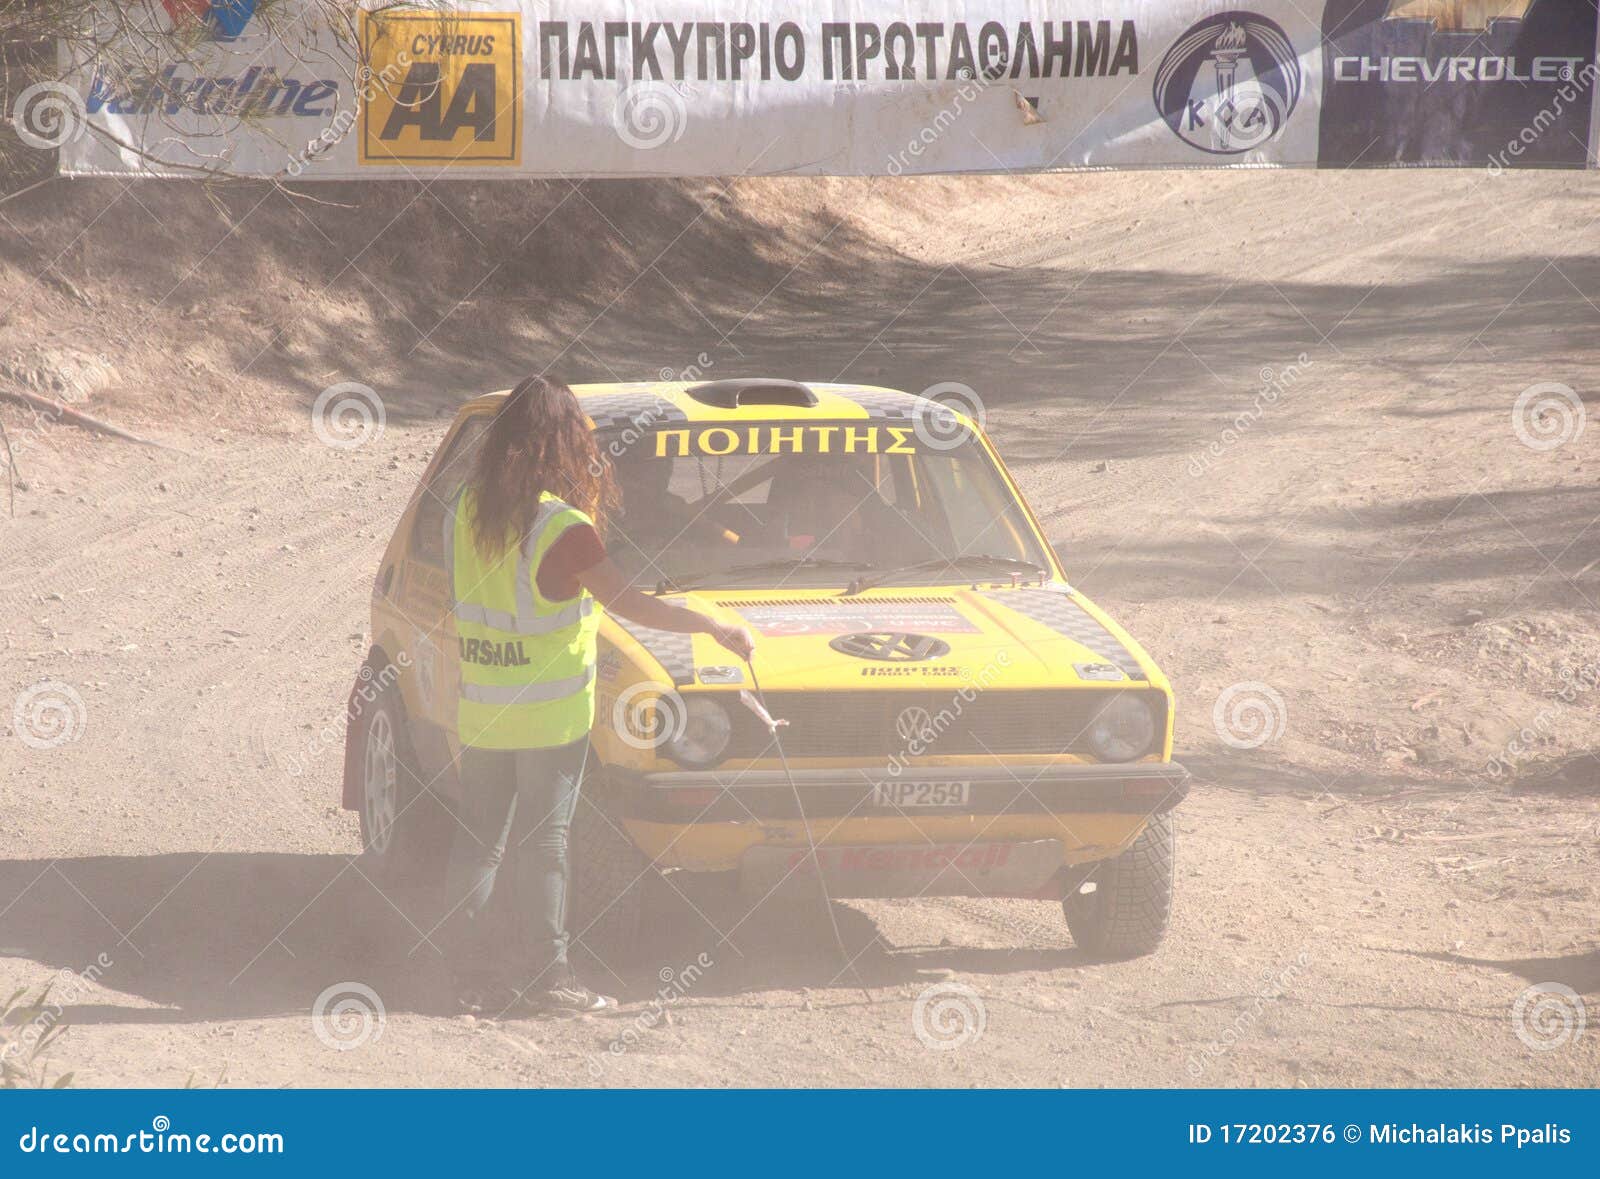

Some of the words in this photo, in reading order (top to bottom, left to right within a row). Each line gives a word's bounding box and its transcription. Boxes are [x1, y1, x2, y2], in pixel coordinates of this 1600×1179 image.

[539, 21, 805, 82] ΠΑΓΚΥΠΡΙΟ
[821, 19, 1140, 82] ΠΡΩΤΑΘΛΗΜΑ
[1333, 56, 1585, 83] CHEVROLET
[379, 62, 497, 142] AA
[655, 426, 917, 458] ΠΟΙΗΤΗΣ
